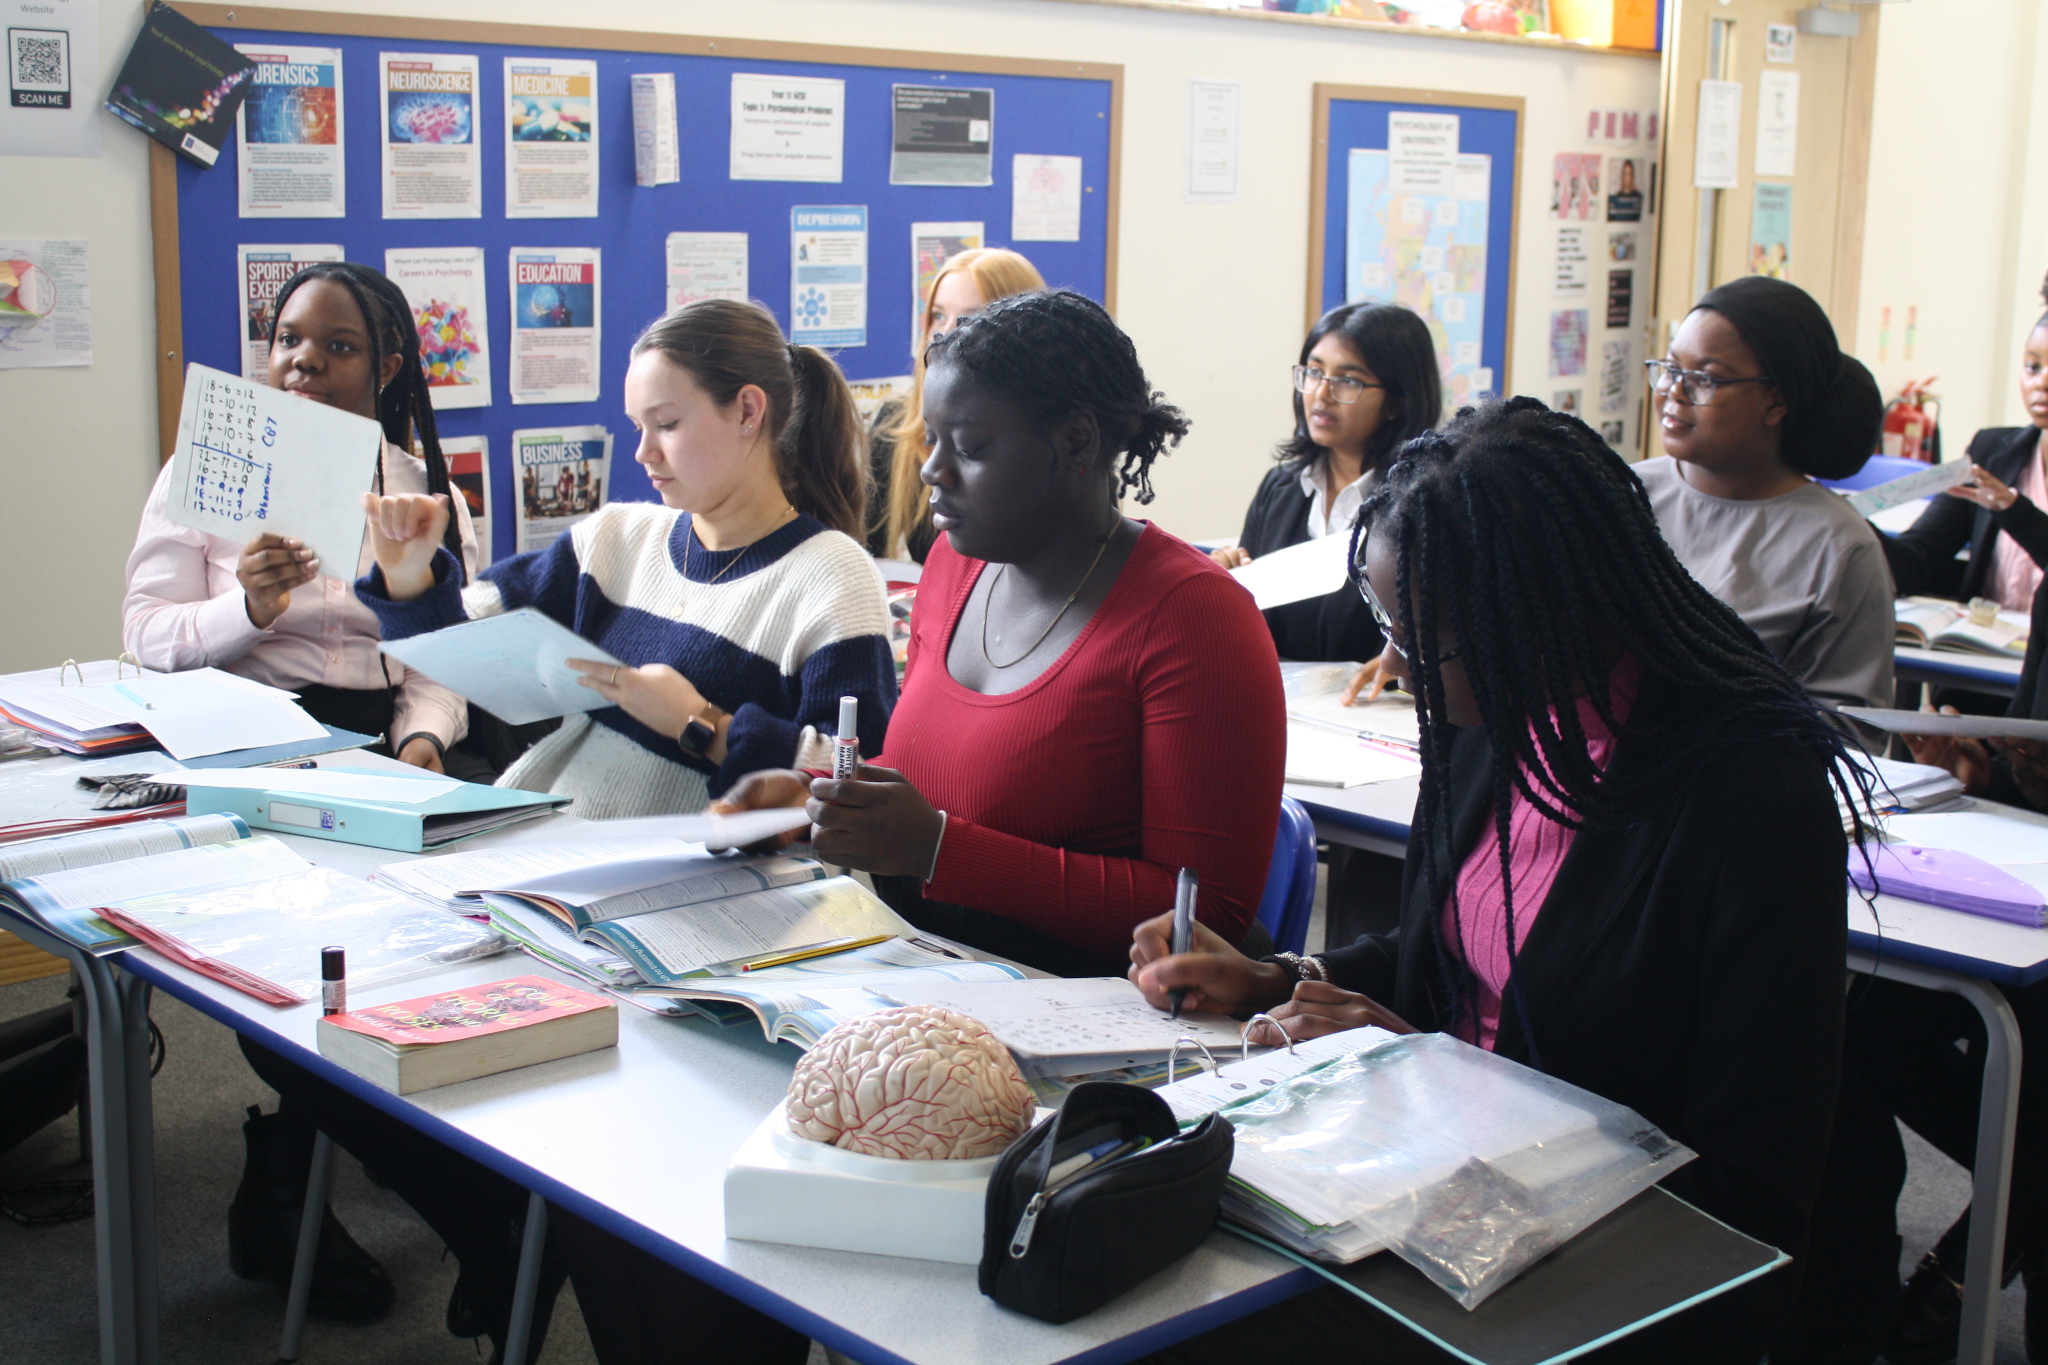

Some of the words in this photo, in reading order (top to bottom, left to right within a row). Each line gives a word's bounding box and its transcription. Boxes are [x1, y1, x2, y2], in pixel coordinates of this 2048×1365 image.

[20, 4, 55, 14] Website
[253, 64, 319, 86] ORENSICS
[389, 71, 470, 92] NEUROSCIENCE
[514, 75, 570, 96] MEDICINE
[20, 94, 46, 105] SCAN
[48, 94, 63, 106] ME
[797, 214, 862, 226] DEPRESSION
[424, 257, 452, 265] Psychology
[248, 262, 294, 280] SPORTS
[434, 268, 473, 278] Psychology
[518, 264, 582, 283] EDUCATION
[522, 442, 583, 466] BUSINESS
[609, 926, 639, 950] depression
[486, 993, 512, 1002] OF
[515, 988, 587, 1011] COURT
[375, 1005, 449, 1032] ROSES
[438, 992, 526, 1026] THORNS
[446, 1015, 483, 1028] AND
